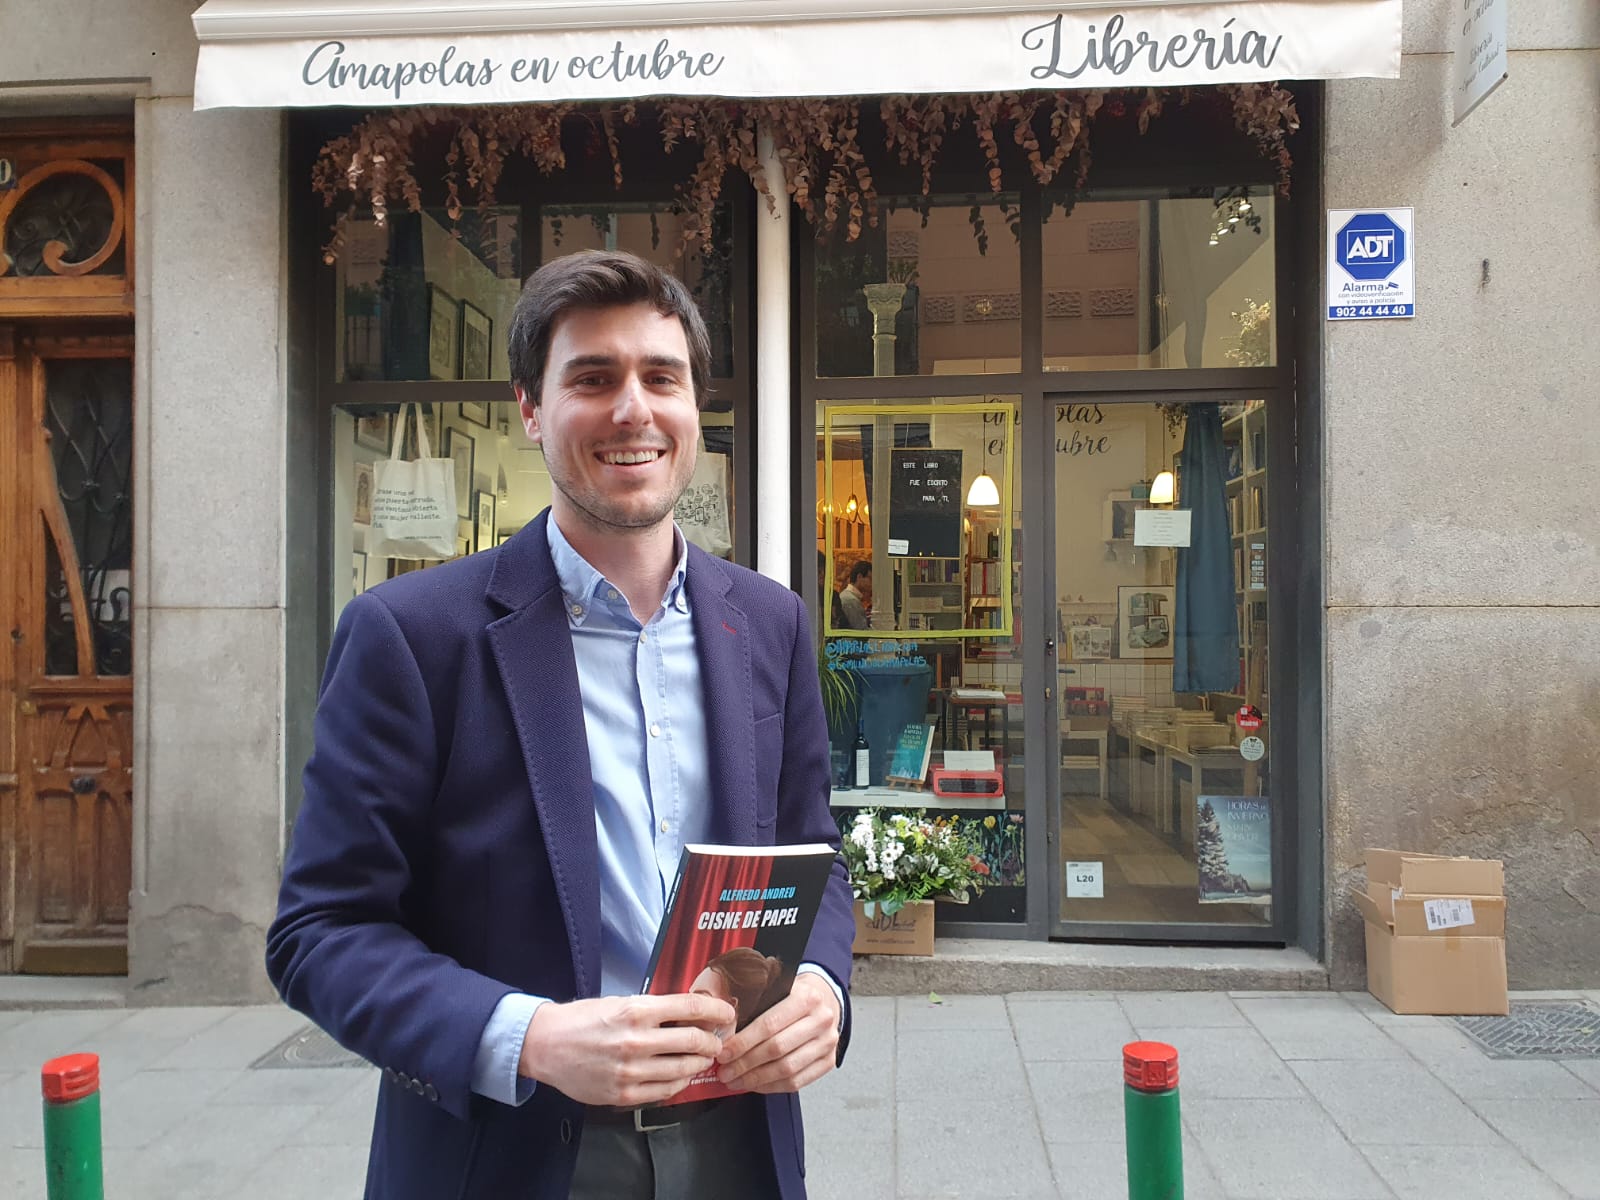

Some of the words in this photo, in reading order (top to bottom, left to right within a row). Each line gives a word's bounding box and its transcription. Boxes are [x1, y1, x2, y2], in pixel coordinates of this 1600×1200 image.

[1021, 13, 1283, 79] Librería
[302, 40, 501, 99] Amapolas
[510, 56, 559, 83] en
[567, 38, 726, 82] octubre
[1347, 235, 1395, 259] ADT
[1342, 283, 1384, 292] Alarma
[1336, 307, 1356, 317] 902
[1359, 306, 1373, 316] 44
[1375, 306, 1389, 315] 44
[1391, 305, 1406, 315] 40
[1076, 875, 1094, 883] L20
[719, 888, 761, 901] ALFREDO
[760, 886, 796, 900] ANDREU
[697, 911, 741, 930] CISNE
[742, 910, 759, 929] DE
[760, 907, 799, 927] PAPEL
